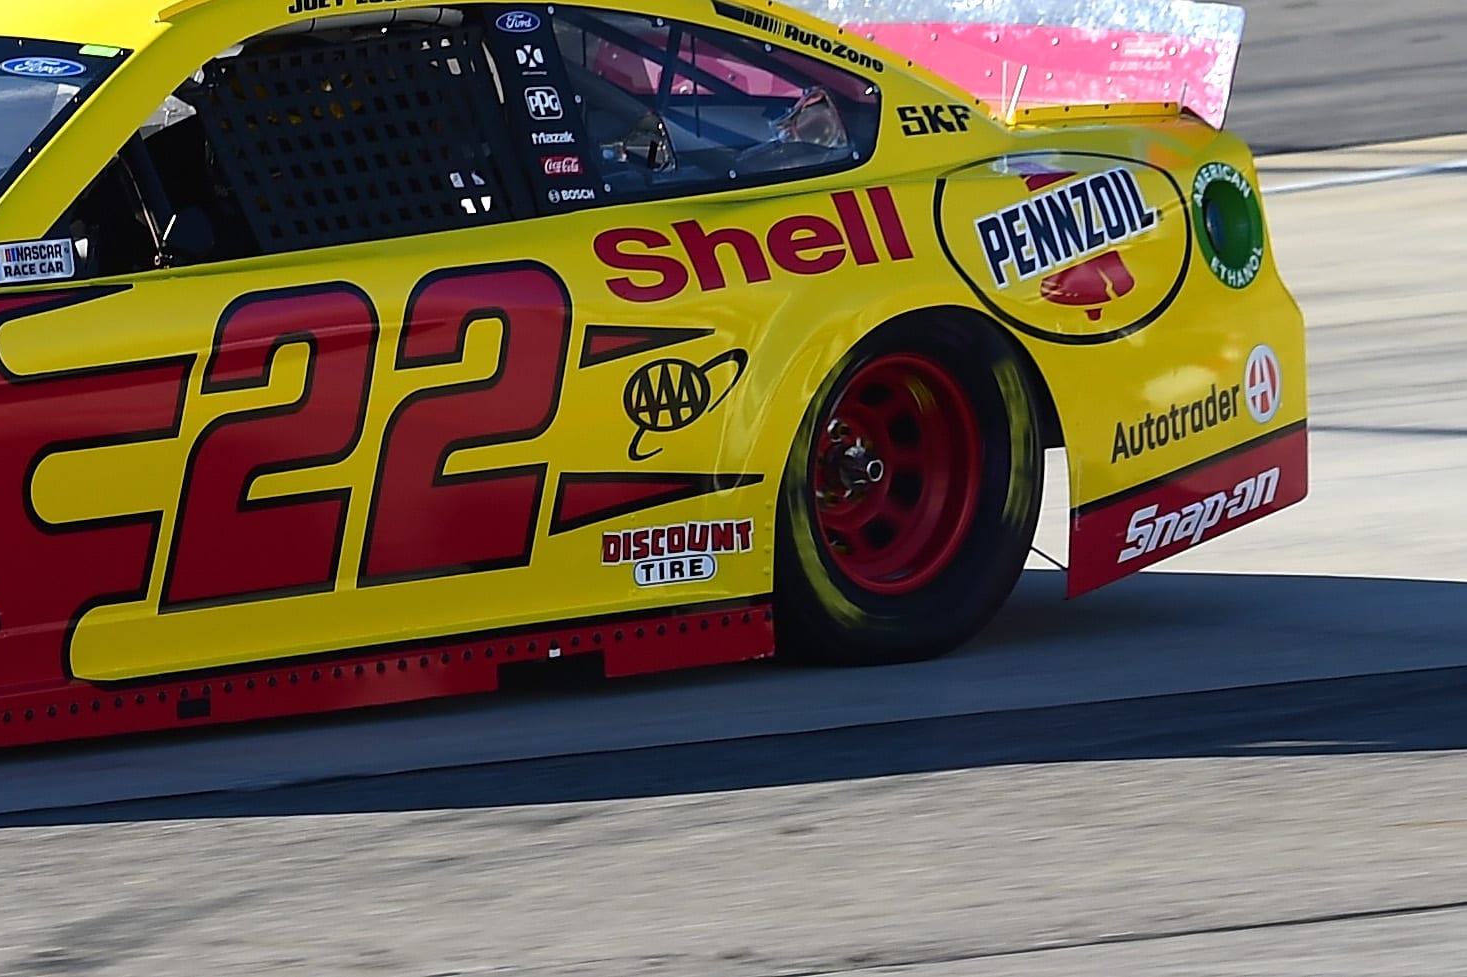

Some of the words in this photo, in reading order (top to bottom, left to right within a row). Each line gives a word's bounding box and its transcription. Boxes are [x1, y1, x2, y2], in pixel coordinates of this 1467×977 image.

[783, 23, 884, 73] AutoZone
[528, 90, 561, 116] PPG
[896, 105, 972, 137] SKF
[531, 131, 575, 145] Mazak
[560, 188, 596, 202] BOSCH
[1193, 163, 1252, 208] AMERICAN
[592, 185, 915, 303] Shell
[976, 168, 1159, 289] PENNZOIL
[3, 262, 37, 278] RACE
[39, 260, 65, 274] CAR
[15, 244, 63, 262] NASCAR
[1211, 247, 1263, 287] ETHANOL
[629, 360, 705, 429] AAA
[158, 259, 573, 614] 22
[1110, 383, 1241, 464] Autotrader
[1116, 466, 1282, 564] Snap-on
[602, 520, 753, 563] DISCOUNT
[640, 558, 705, 582] TIRE
